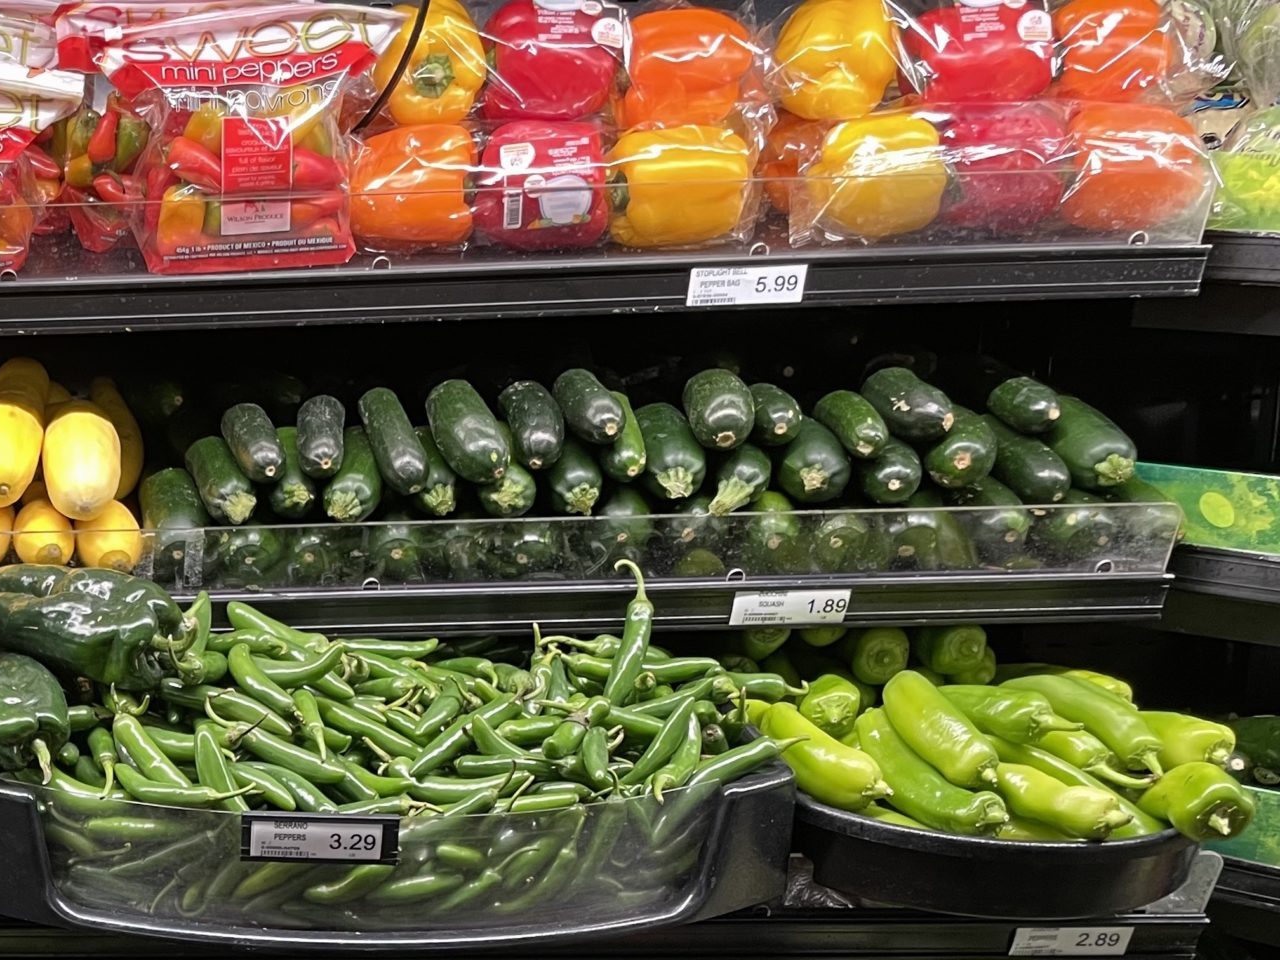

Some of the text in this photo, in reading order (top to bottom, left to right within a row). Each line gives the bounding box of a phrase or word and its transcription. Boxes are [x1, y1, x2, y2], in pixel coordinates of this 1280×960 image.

[122, 11, 373, 63] sweet
[161, 53, 338, 84] mini peppers
[207, 243, 234, 251] PRODUCT
[755, 274, 799, 293] 5.99
[807, 598, 847, 614] 1.89
[274, 821, 308, 829] SERRANO
[274, 833, 306, 841] PEPPERS
[329, 833, 376, 851] 3.29
[1075, 932, 1120, 947] 2.89
